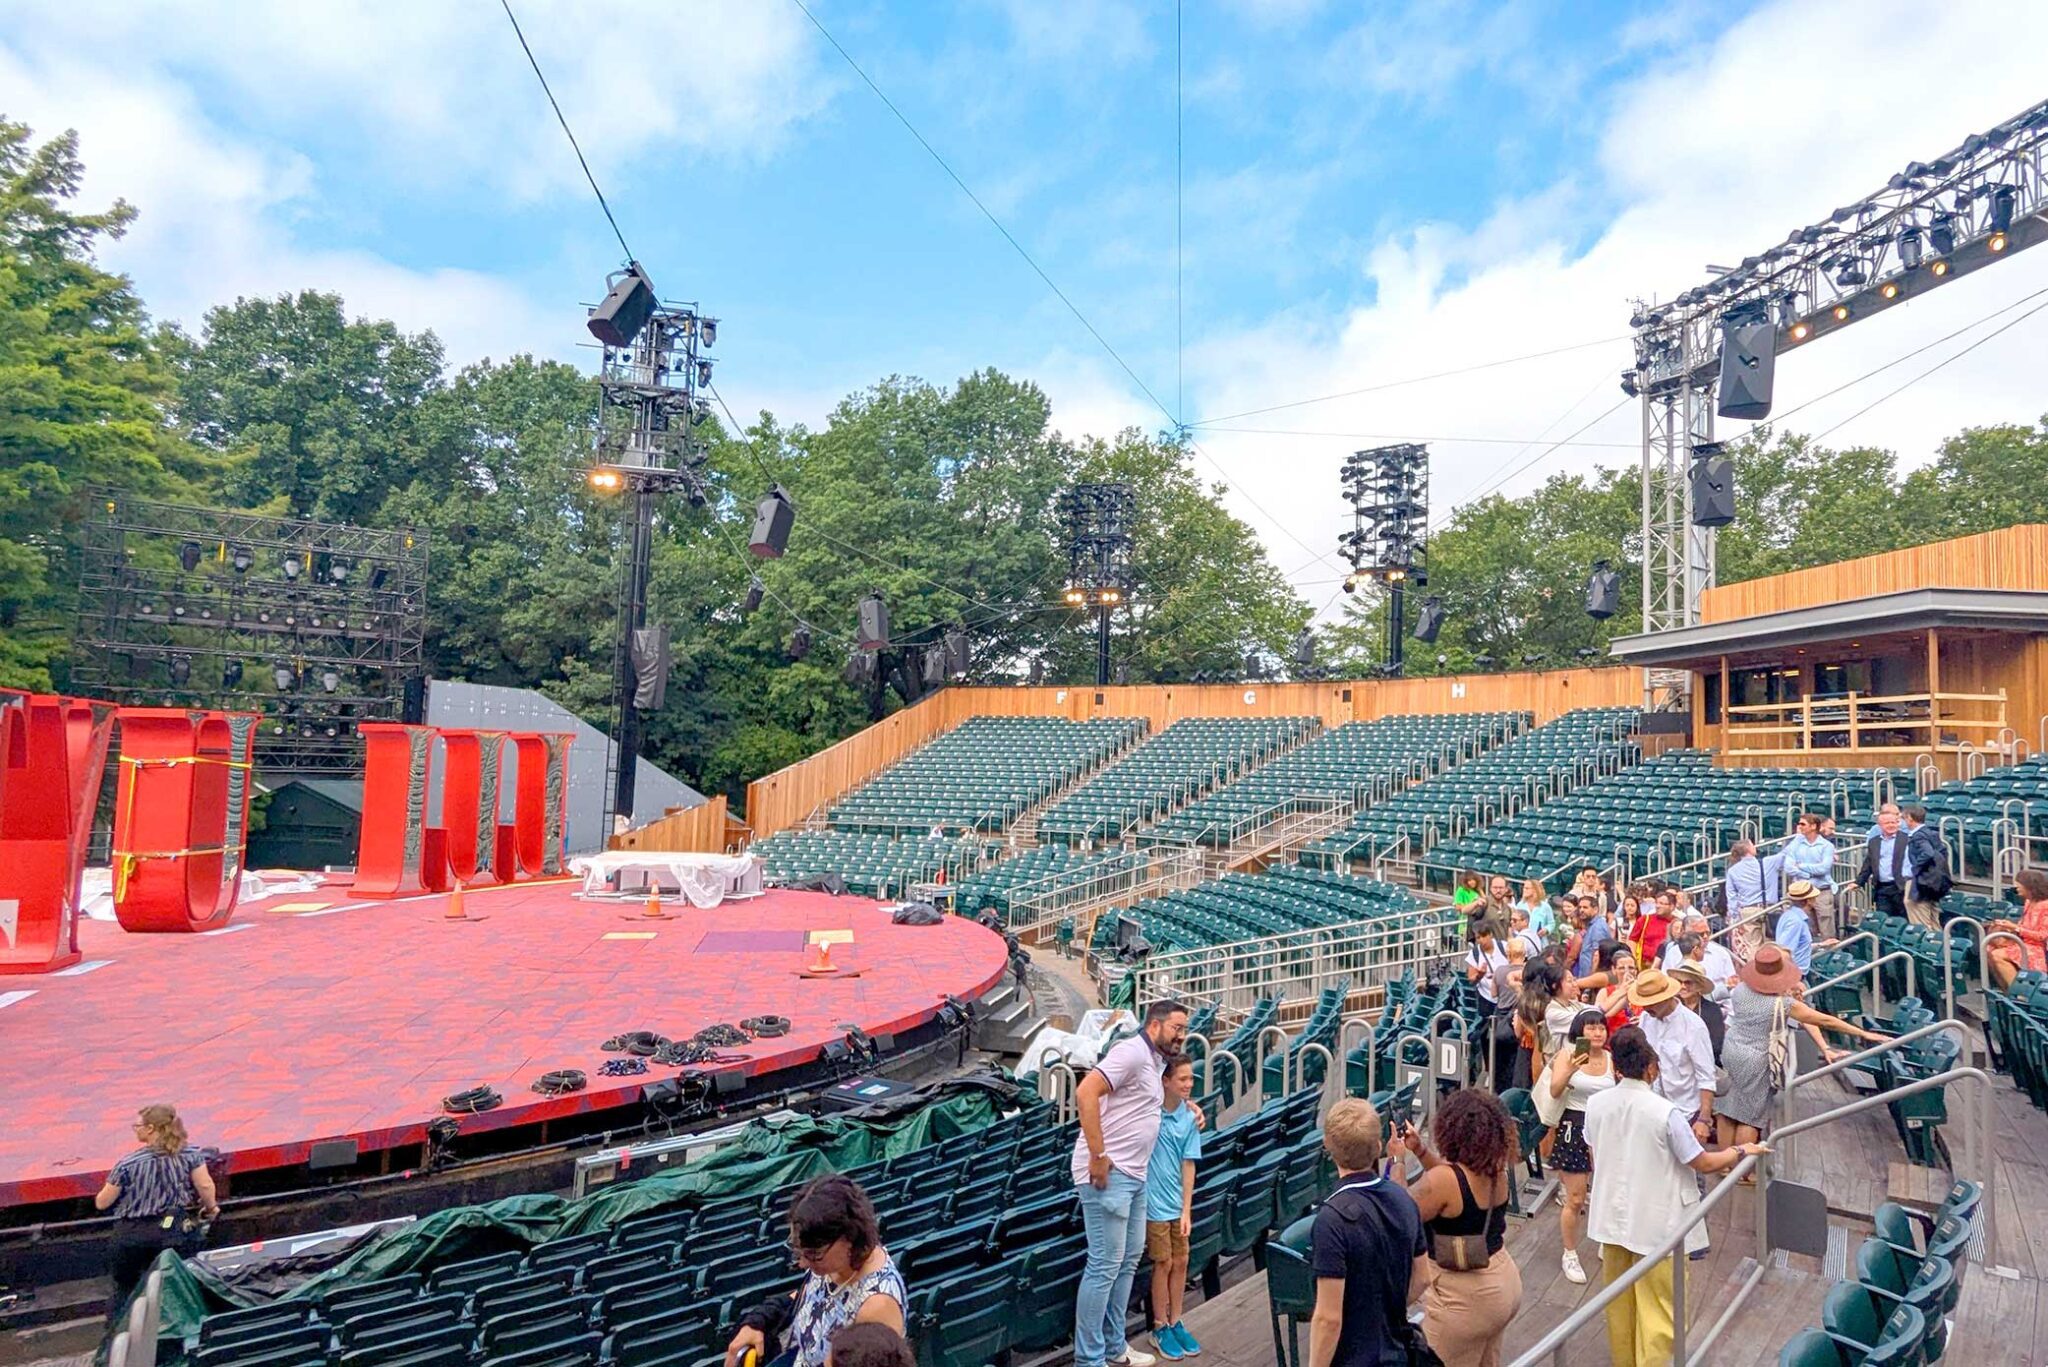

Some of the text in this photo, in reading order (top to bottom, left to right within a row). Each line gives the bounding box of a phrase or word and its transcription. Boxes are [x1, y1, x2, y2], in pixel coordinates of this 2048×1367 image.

[1056, 691, 1068, 705] F
[1243, 690, 1256, 705] G
[1452, 683, 1466, 699] H
[1441, 1043, 1457, 1075] D
